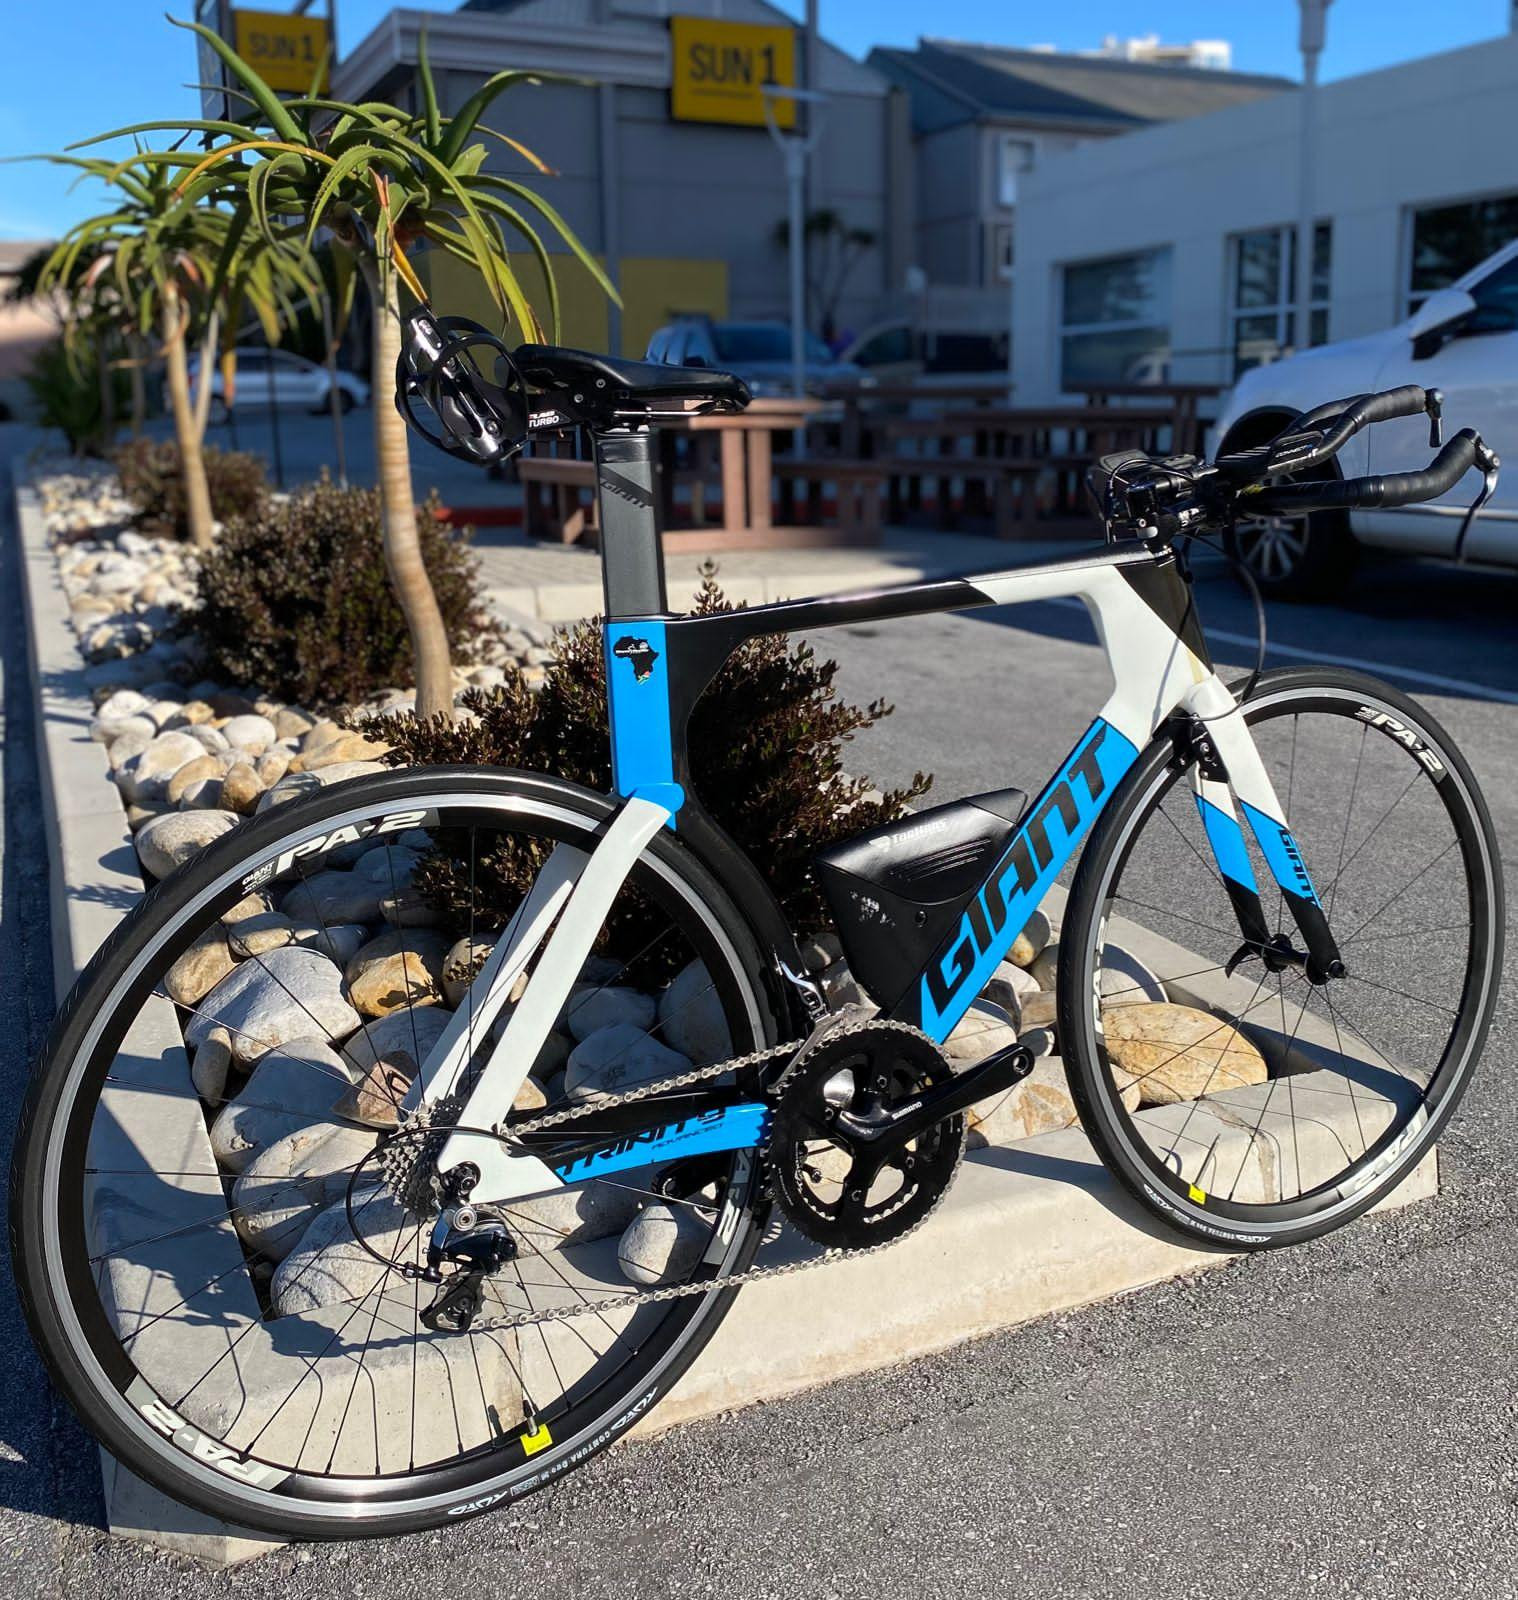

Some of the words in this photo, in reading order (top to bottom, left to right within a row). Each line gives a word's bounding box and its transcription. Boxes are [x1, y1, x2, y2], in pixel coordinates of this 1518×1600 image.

[248, 32, 296, 59] SUN
[302, 33, 316, 61] 1
[689, 42, 754, 84] SUN
[761, 43, 776, 85] 1
[528, 415, 560, 428] TURBO
[600, 480, 650, 508] GIANT
[1370, 713, 1445, 773] PA-2
[275, 810, 428, 875] PA-2
[1277, 828, 1320, 907] GIANT
[924, 722, 1108, 1018] GIANT
[891, 1101, 923, 1120] SHIMANO
[717, 1148, 752, 1246] A-2
